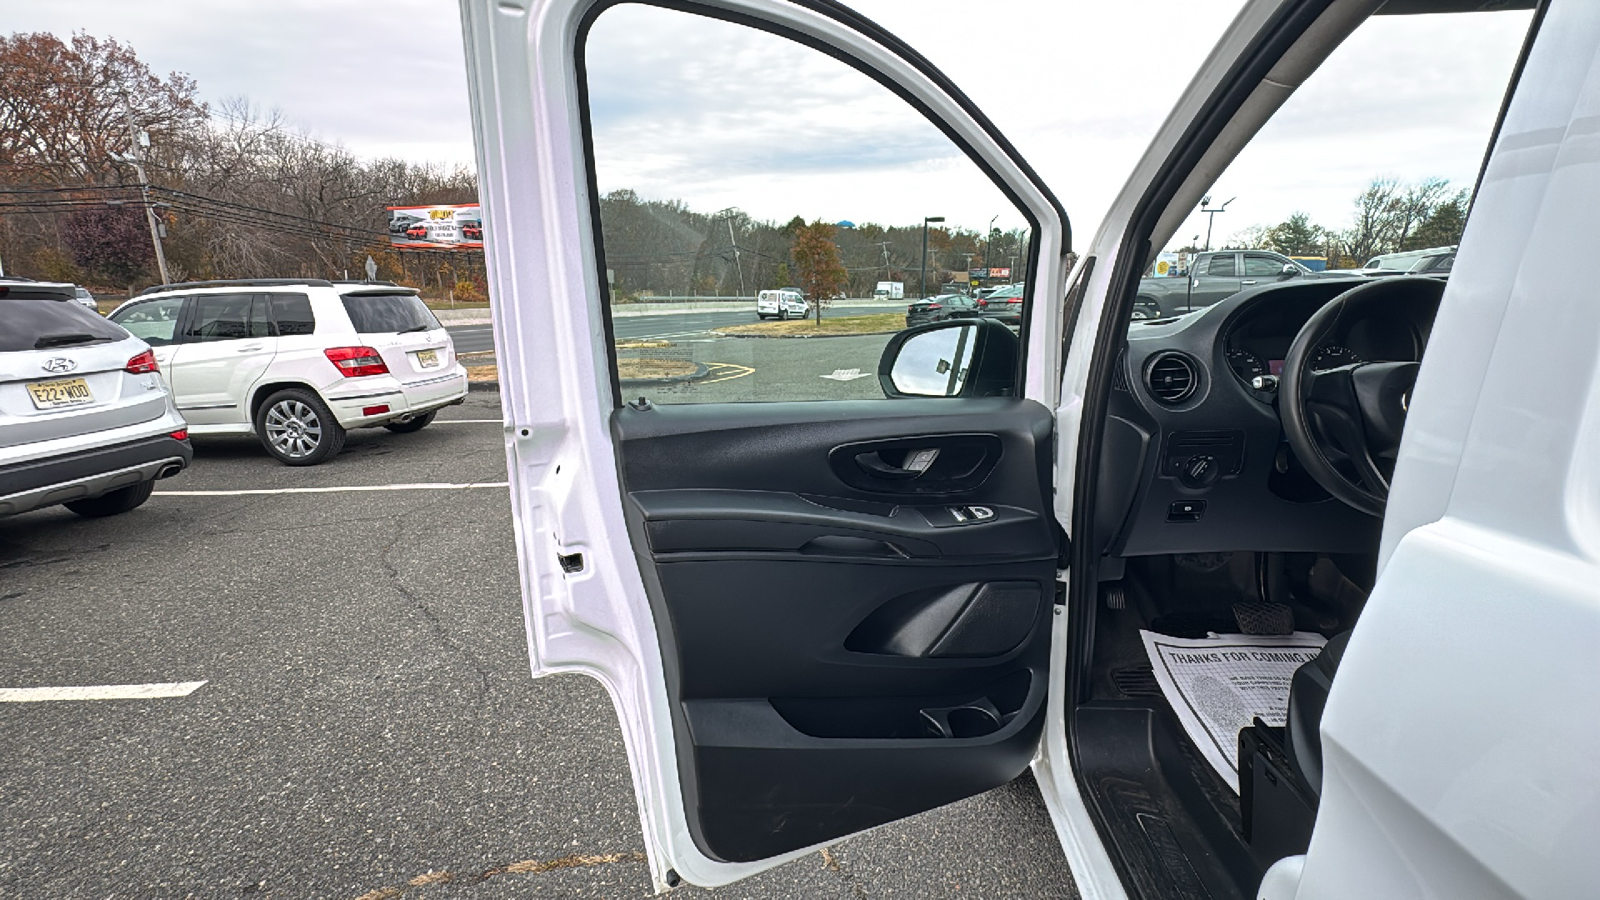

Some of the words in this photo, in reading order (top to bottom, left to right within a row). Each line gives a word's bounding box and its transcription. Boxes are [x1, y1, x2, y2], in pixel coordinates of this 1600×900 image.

[1168, 652, 1222, 664] THANKS
[1221, 652, 1251, 662] FOR
[1251, 652, 1305, 663] COMING
